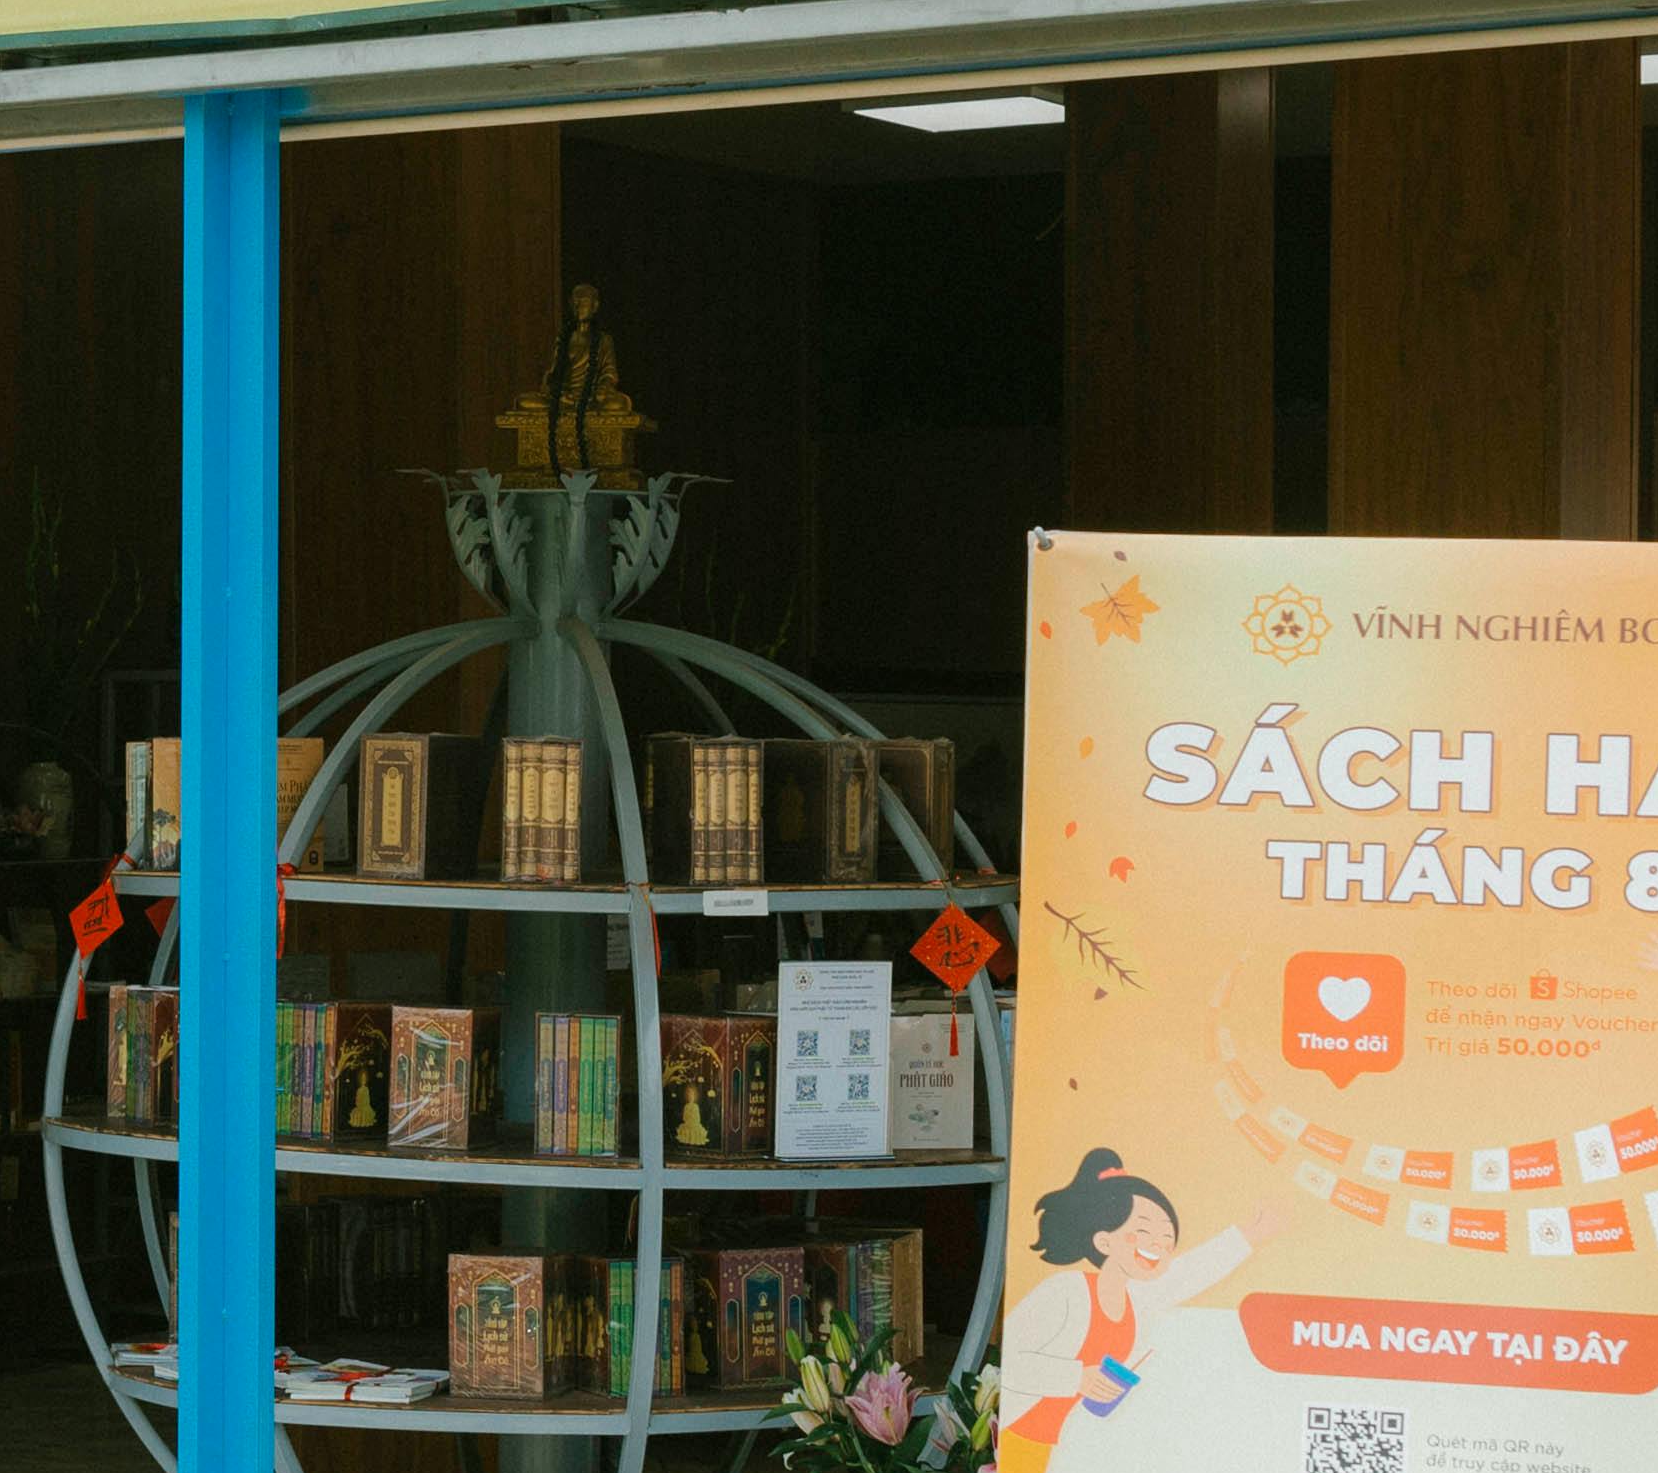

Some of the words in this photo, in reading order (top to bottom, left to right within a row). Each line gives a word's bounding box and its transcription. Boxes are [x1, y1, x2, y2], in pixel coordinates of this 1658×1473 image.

[1351, 606, 1442, 641] VĨNH
[1455, 609, 1605, 644] NGHIÊM
[1143, 702, 1495, 814] SÁCH
[1266, 827, 1594, 912] THÁNG
[1426, 980, 1478, 999] Theo
[1484, 981, 1518, 1000] dõi
[1563, 980, 1639, 1002] Shopee
[1425, 1005, 1451, 1024] để
[1456, 1009, 1508, 1030] nhận
[1514, 1014, 1565, 1033] ngay
[1297, 1032, 1350, 1052] Theo
[1353, 1034, 1389, 1053] dõi
[1424, 1036, 1453, 1057] Trị
[1458, 1037, 1490, 1058] giá
[899, 1070, 927, 1092] PHẬT
[929, 1070, 955, 1088] GIÁO
[1292, 1320, 1372, 1351] MUA
[1380, 1326, 1479, 1356] NGAY
[1486, 1331, 1544, 1366] TẠI
[1552, 1330, 1629, 1365] ĐÂY
[1426, 1433, 1467, 1450] Quét
[1472, 1438, 1498, 1452] mã
[1502, 1439, 1530, 1454] QR
[1534, 1443, 1565, 1459] này
[1426, 1451, 1447, 1468] để
[1451, 1456, 1485, 1472] truy
